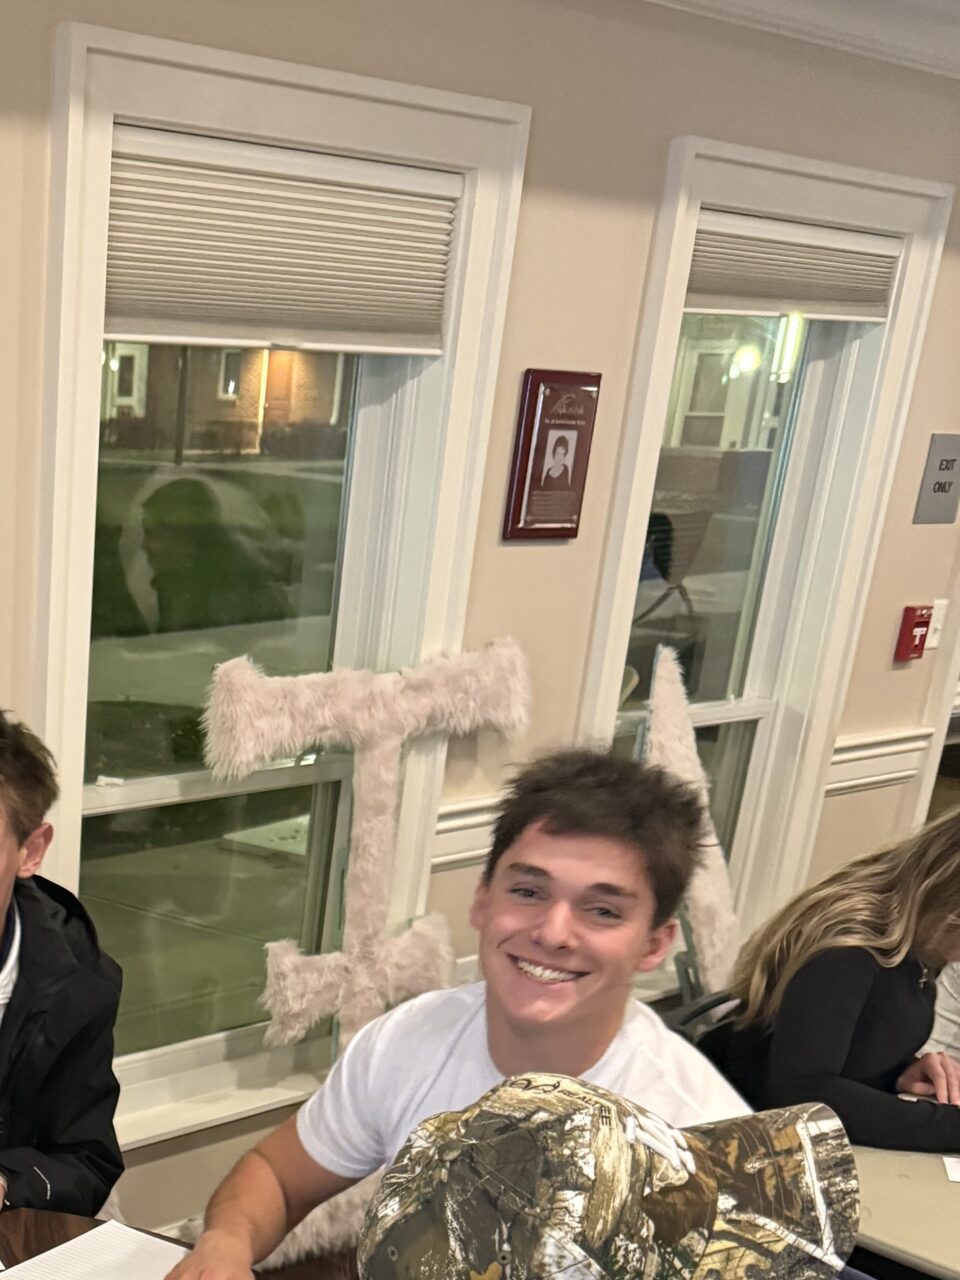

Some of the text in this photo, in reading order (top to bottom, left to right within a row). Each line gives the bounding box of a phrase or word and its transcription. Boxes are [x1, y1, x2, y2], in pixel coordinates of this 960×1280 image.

[938, 458, 957, 471] EXIT
[932, 481, 954, 494] ONLY
[557, 1088, 612, 1127] REALTEE
